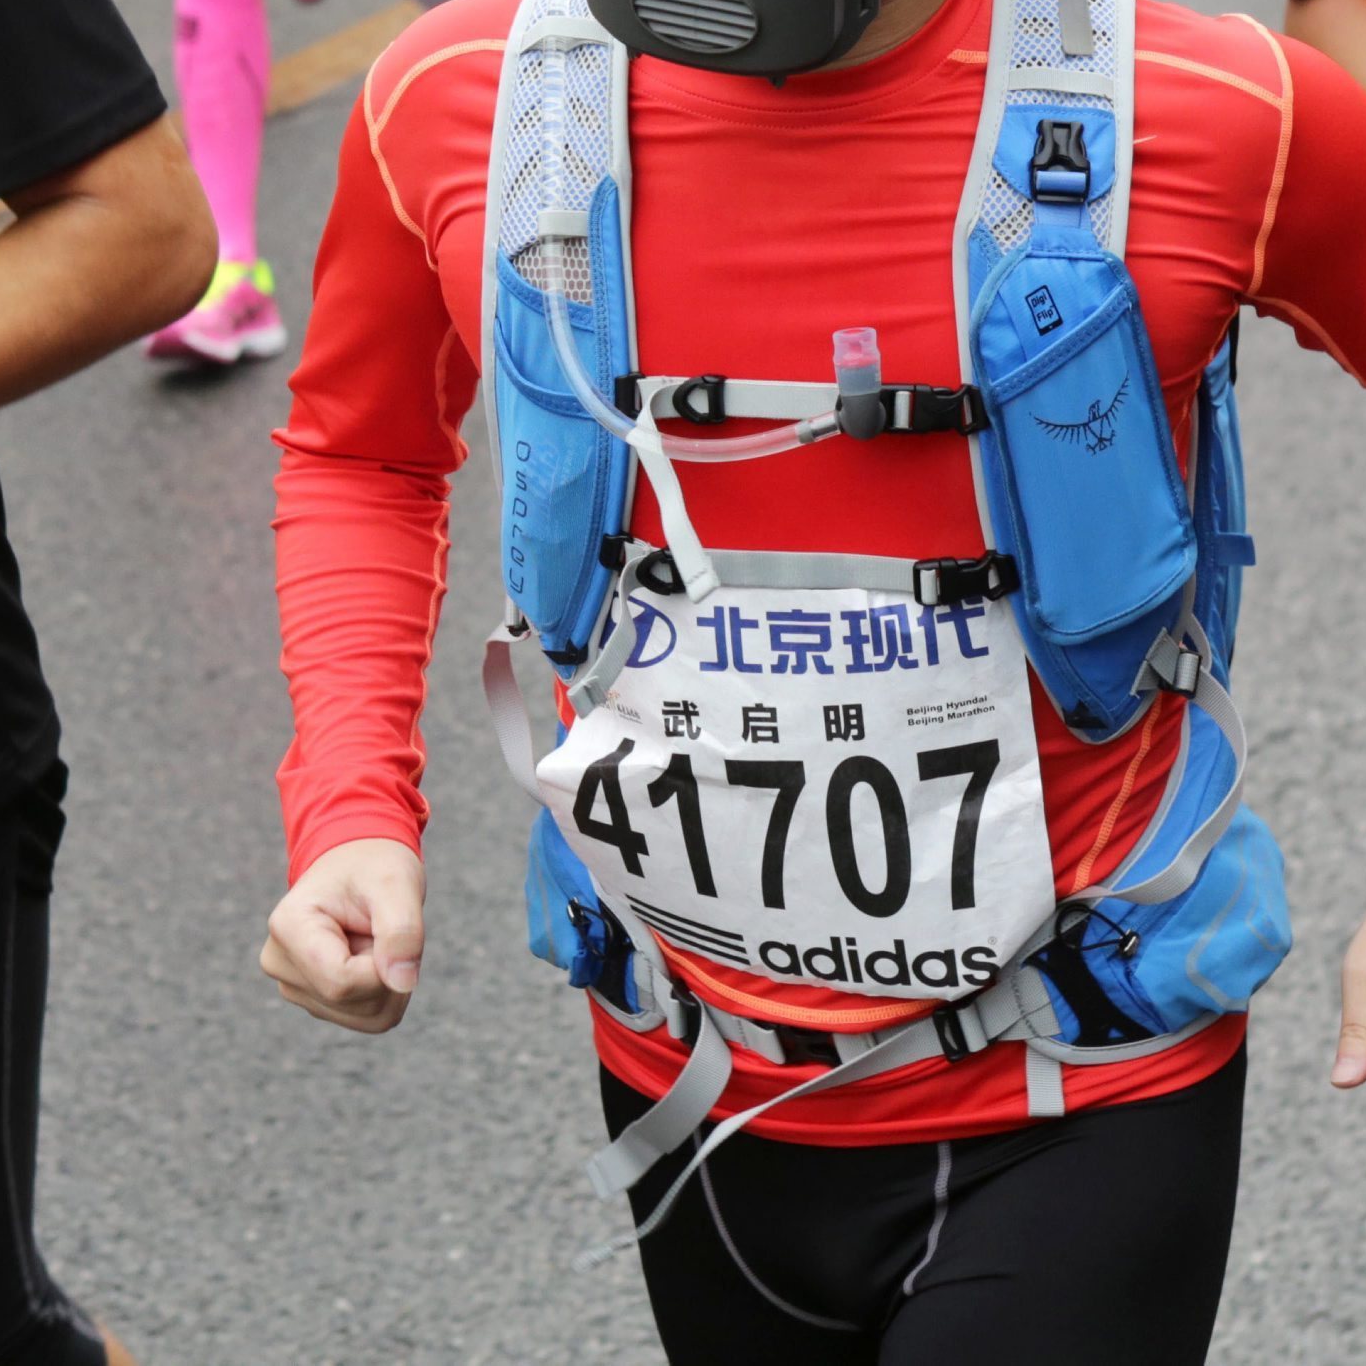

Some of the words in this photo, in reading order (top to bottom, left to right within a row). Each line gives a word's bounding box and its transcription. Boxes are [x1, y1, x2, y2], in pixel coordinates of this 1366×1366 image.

[696, 596, 990, 676] 北京现代
[906, 705, 943, 715] Beijing
[946, 695, 988, 710] Hyundai
[907, 715, 944, 726] Beijing
[947, 705, 995, 720] Marathon
[572, 737, 1001, 919] 41707
[758, 936, 998, 988] adidas
